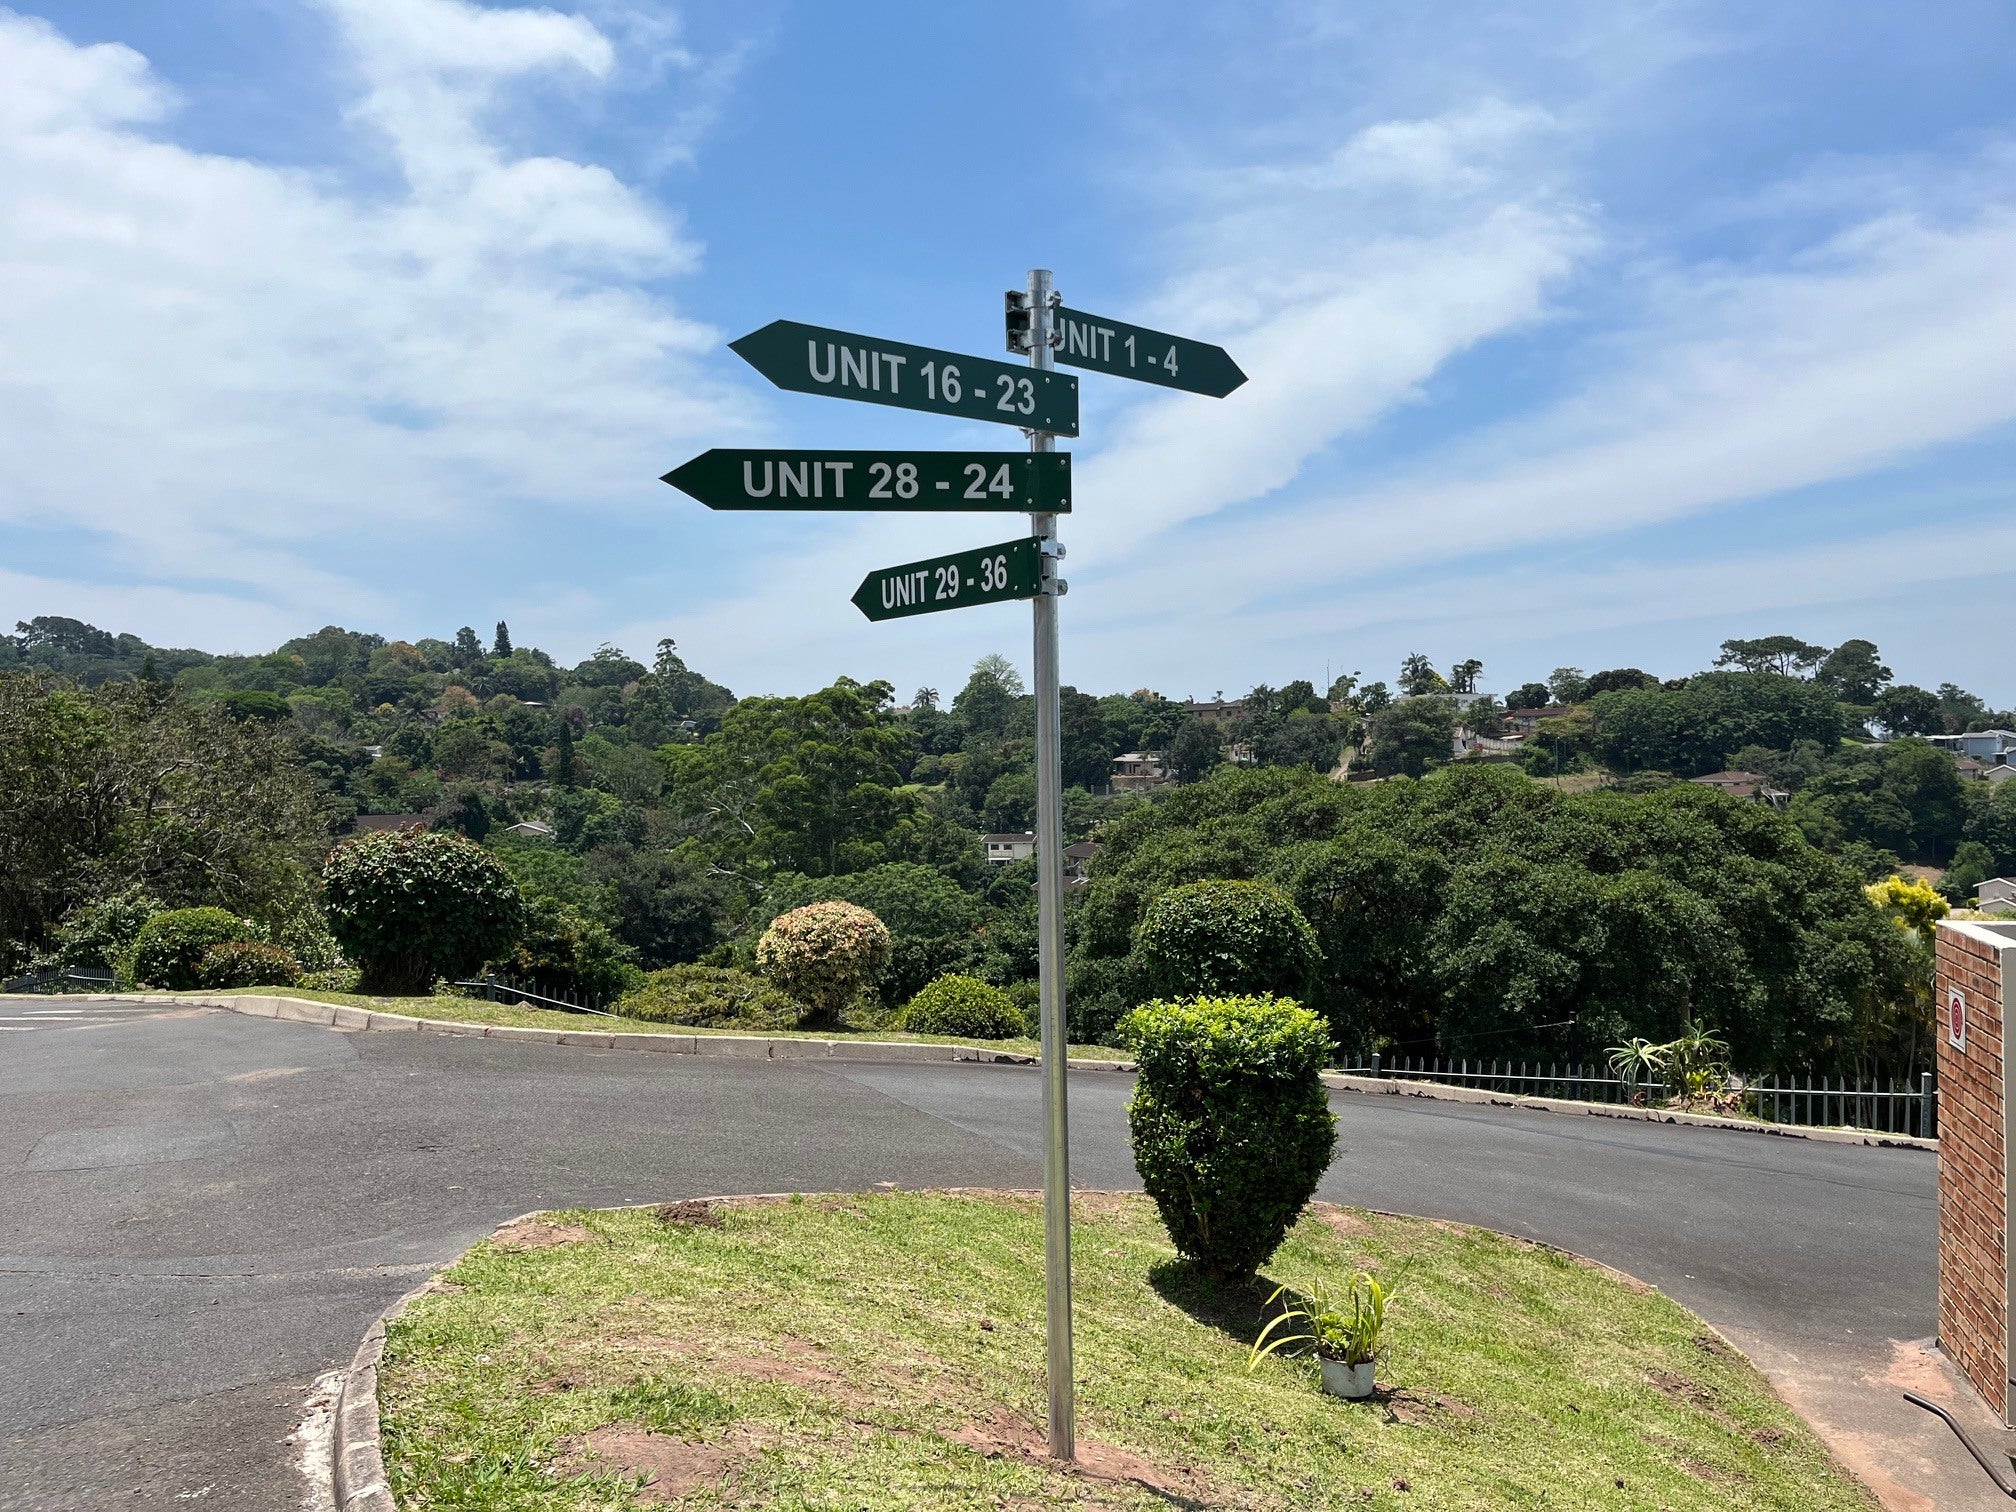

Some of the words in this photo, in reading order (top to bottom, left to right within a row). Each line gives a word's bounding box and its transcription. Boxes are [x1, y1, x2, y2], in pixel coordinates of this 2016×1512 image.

[808, 339, 907, 394] UNIT
[920, 361, 962, 403] 16
[974, 388, 986, 398] -
[996, 374, 1036, 415] 23
[1124, 335, 1135, 368] 1
[1148, 356, 1157, 364] -
[1163, 345, 1179, 377] 4
[743, 461, 854, 498] UNIT
[868, 462, 919, 499] 28
[935, 481, 950, 490] -
[963, 463, 1014, 499] 24
[881, 570, 929, 609] UNIT
[935, 564, 960, 600] 29
[966, 578, 975, 586] -
[980, 554, 1008, 592] 36
